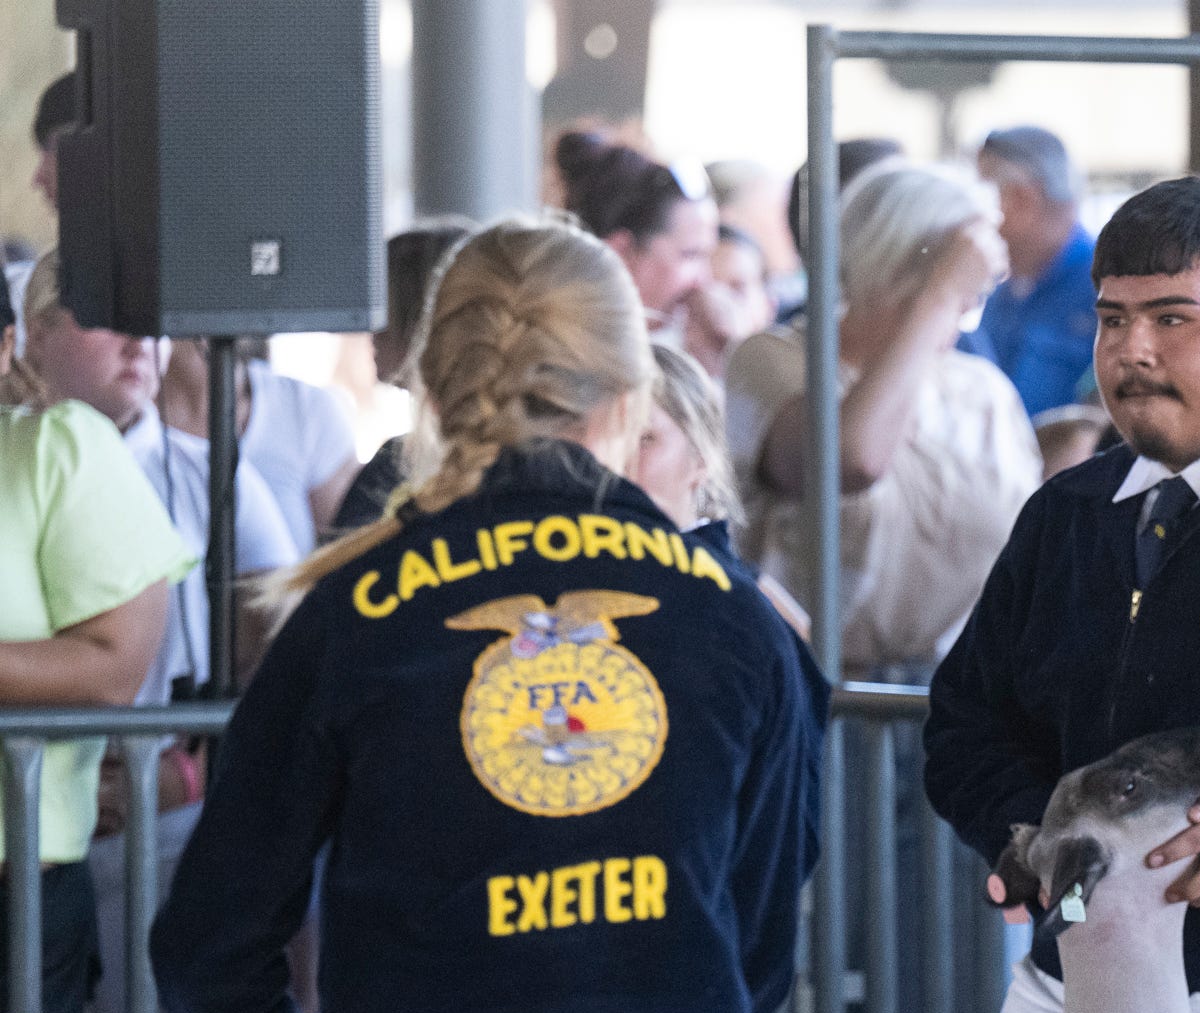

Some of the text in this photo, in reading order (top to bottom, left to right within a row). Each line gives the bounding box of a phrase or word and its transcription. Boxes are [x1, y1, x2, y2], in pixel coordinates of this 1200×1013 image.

[352, 514, 732, 619] CALIFORNIA
[527, 681, 597, 709] FFA
[487, 854, 668, 937] EXETER
